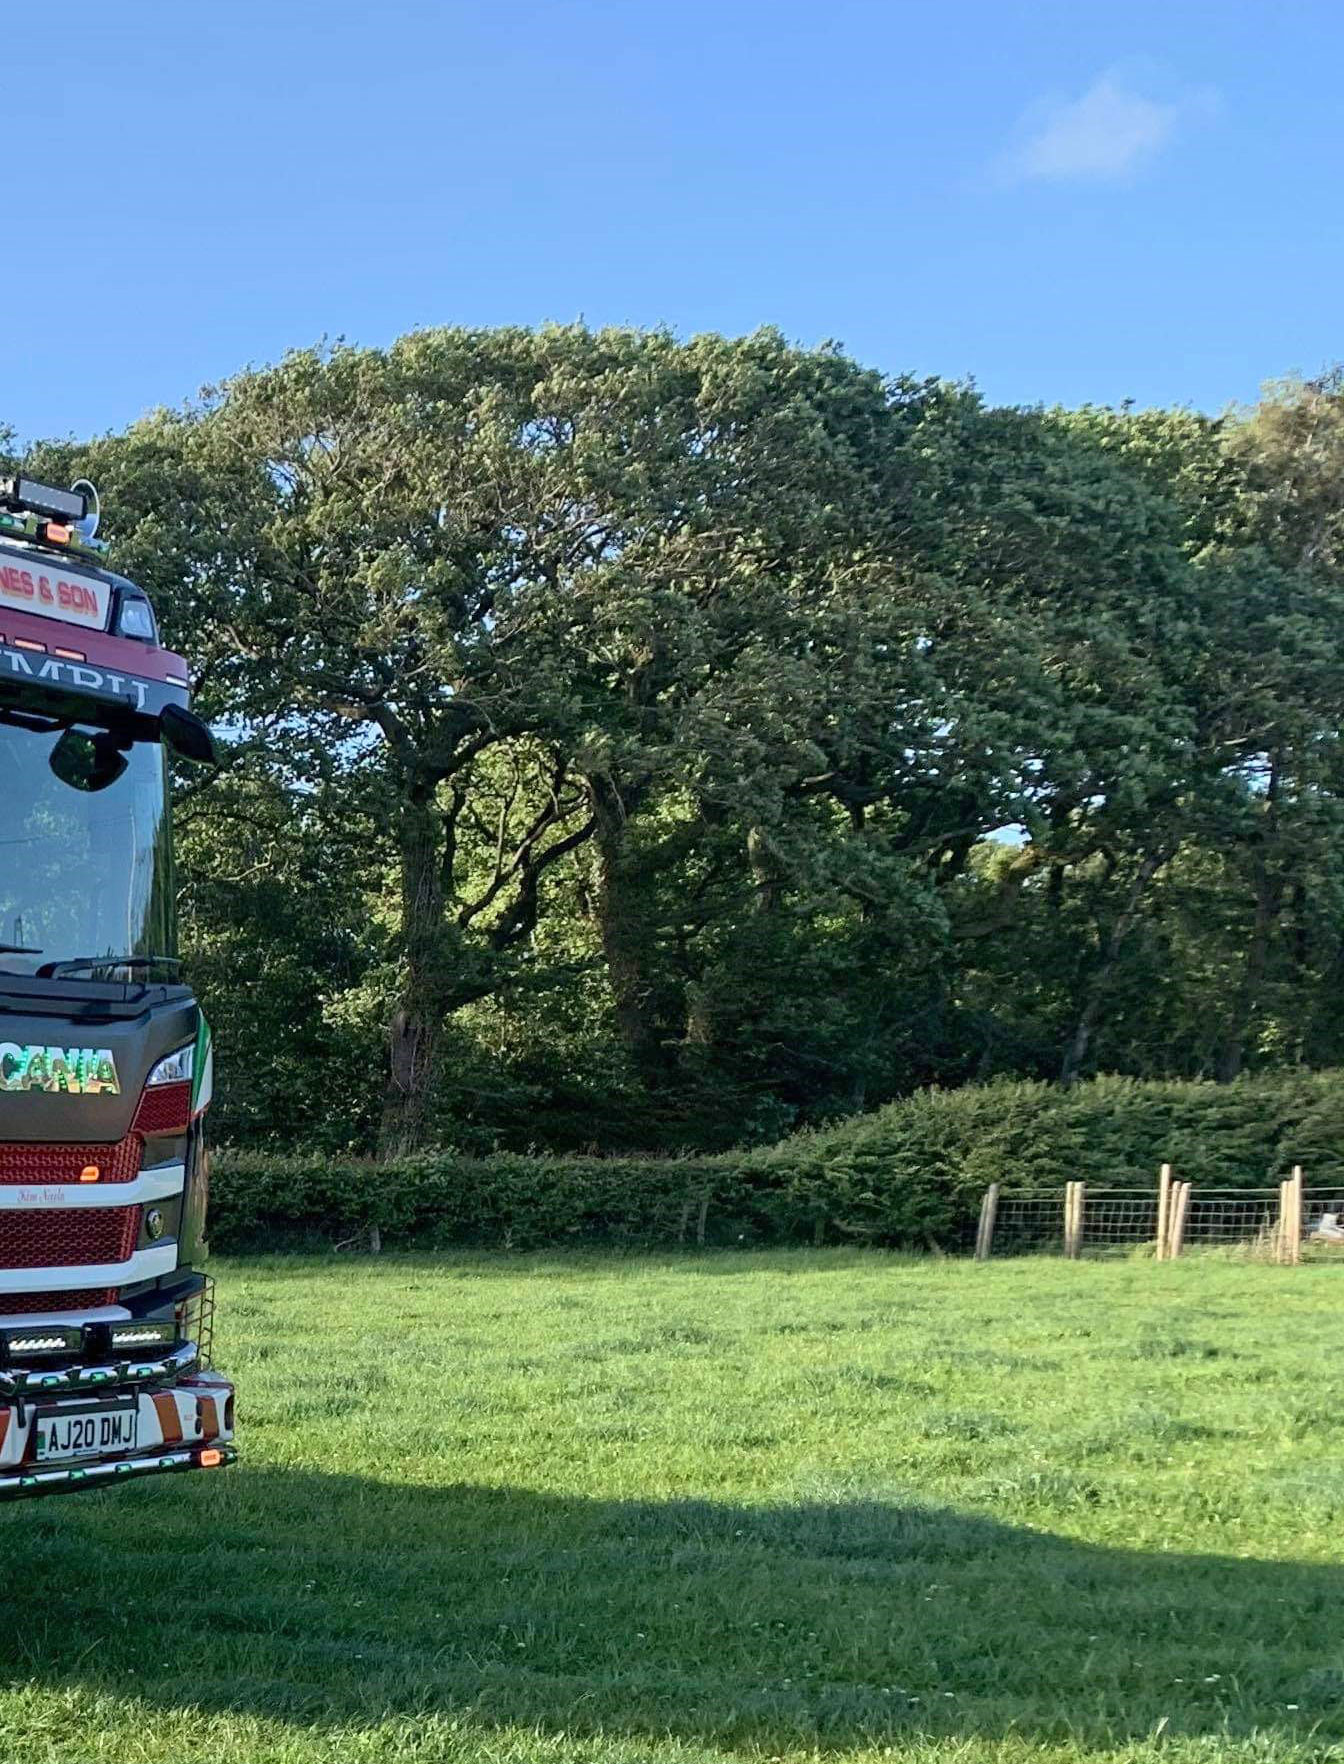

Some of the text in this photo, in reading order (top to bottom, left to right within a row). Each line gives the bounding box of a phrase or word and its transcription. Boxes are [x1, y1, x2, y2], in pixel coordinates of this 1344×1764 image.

[38, 576, 54, 603] &
[56, 581, 99, 617] SON
[49, 1415, 133, 1451] AJ20 DMJ
